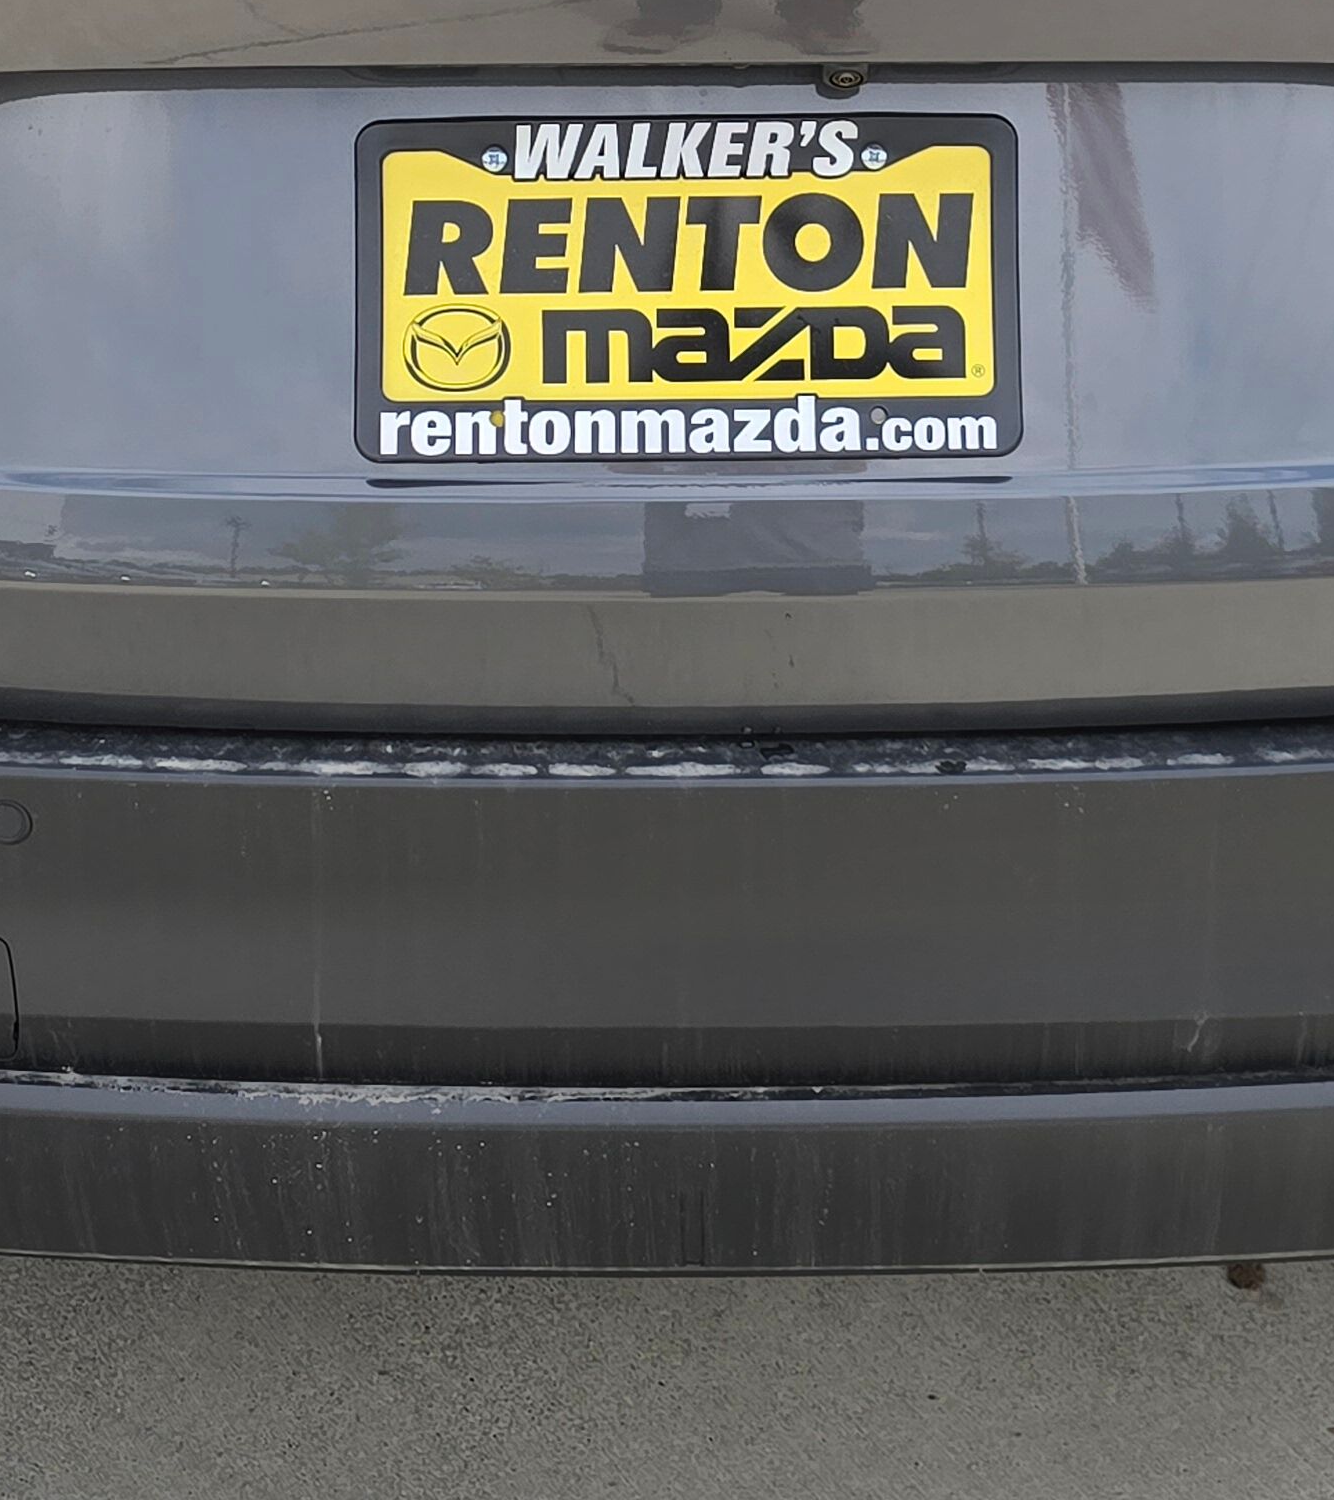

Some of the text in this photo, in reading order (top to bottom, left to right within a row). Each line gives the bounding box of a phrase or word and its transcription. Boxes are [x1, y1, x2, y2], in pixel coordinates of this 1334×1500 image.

[513, 121, 858, 180] WALKER'S
[403, 193, 974, 296] RENTON
[379, 395, 997, 455] rentonmazda.com
